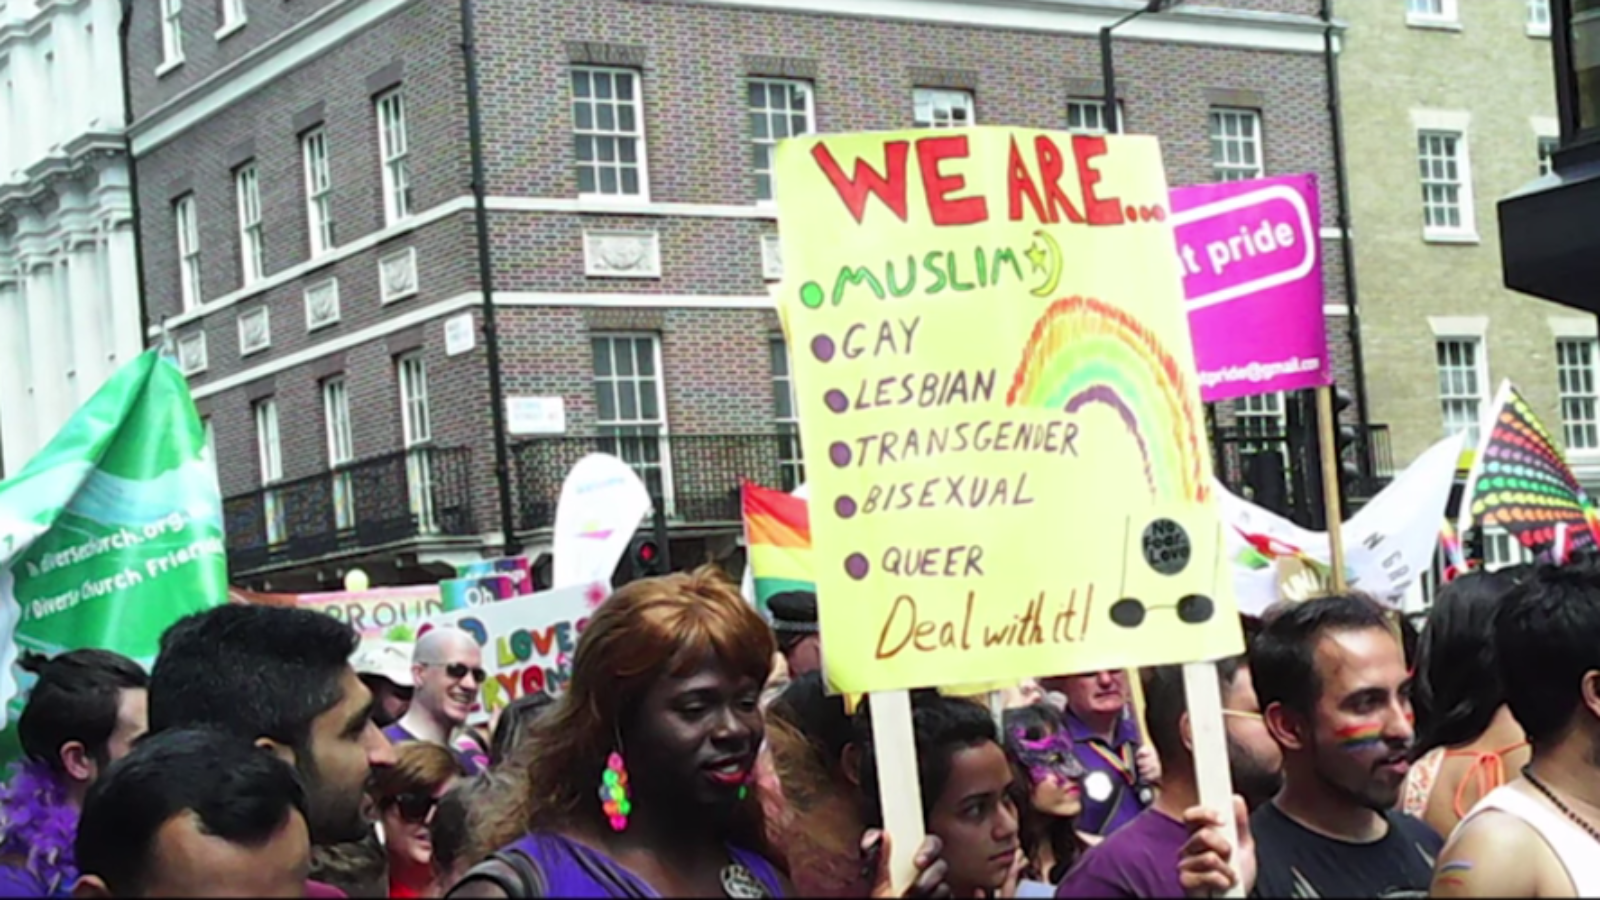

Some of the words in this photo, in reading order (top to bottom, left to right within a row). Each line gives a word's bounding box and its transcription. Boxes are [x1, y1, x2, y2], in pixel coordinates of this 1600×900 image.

[810, 134, 989, 226] WE
[1205, 219, 1295, 275] pride
[832, 246, 1023, 305] MUSLIM
[841, 316, 920, 359] GAY
[854, 368, 996, 411] LESBIAN
[854, 420, 1080, 467] TRANSGENDER
[861, 472, 1034, 515] BISEXUAL
[881, 545, 984, 577] QUEER
[875, 591, 974, 660] Deal
[983, 590, 1045, 648] with
[1051, 583, 1094, 643] it!
